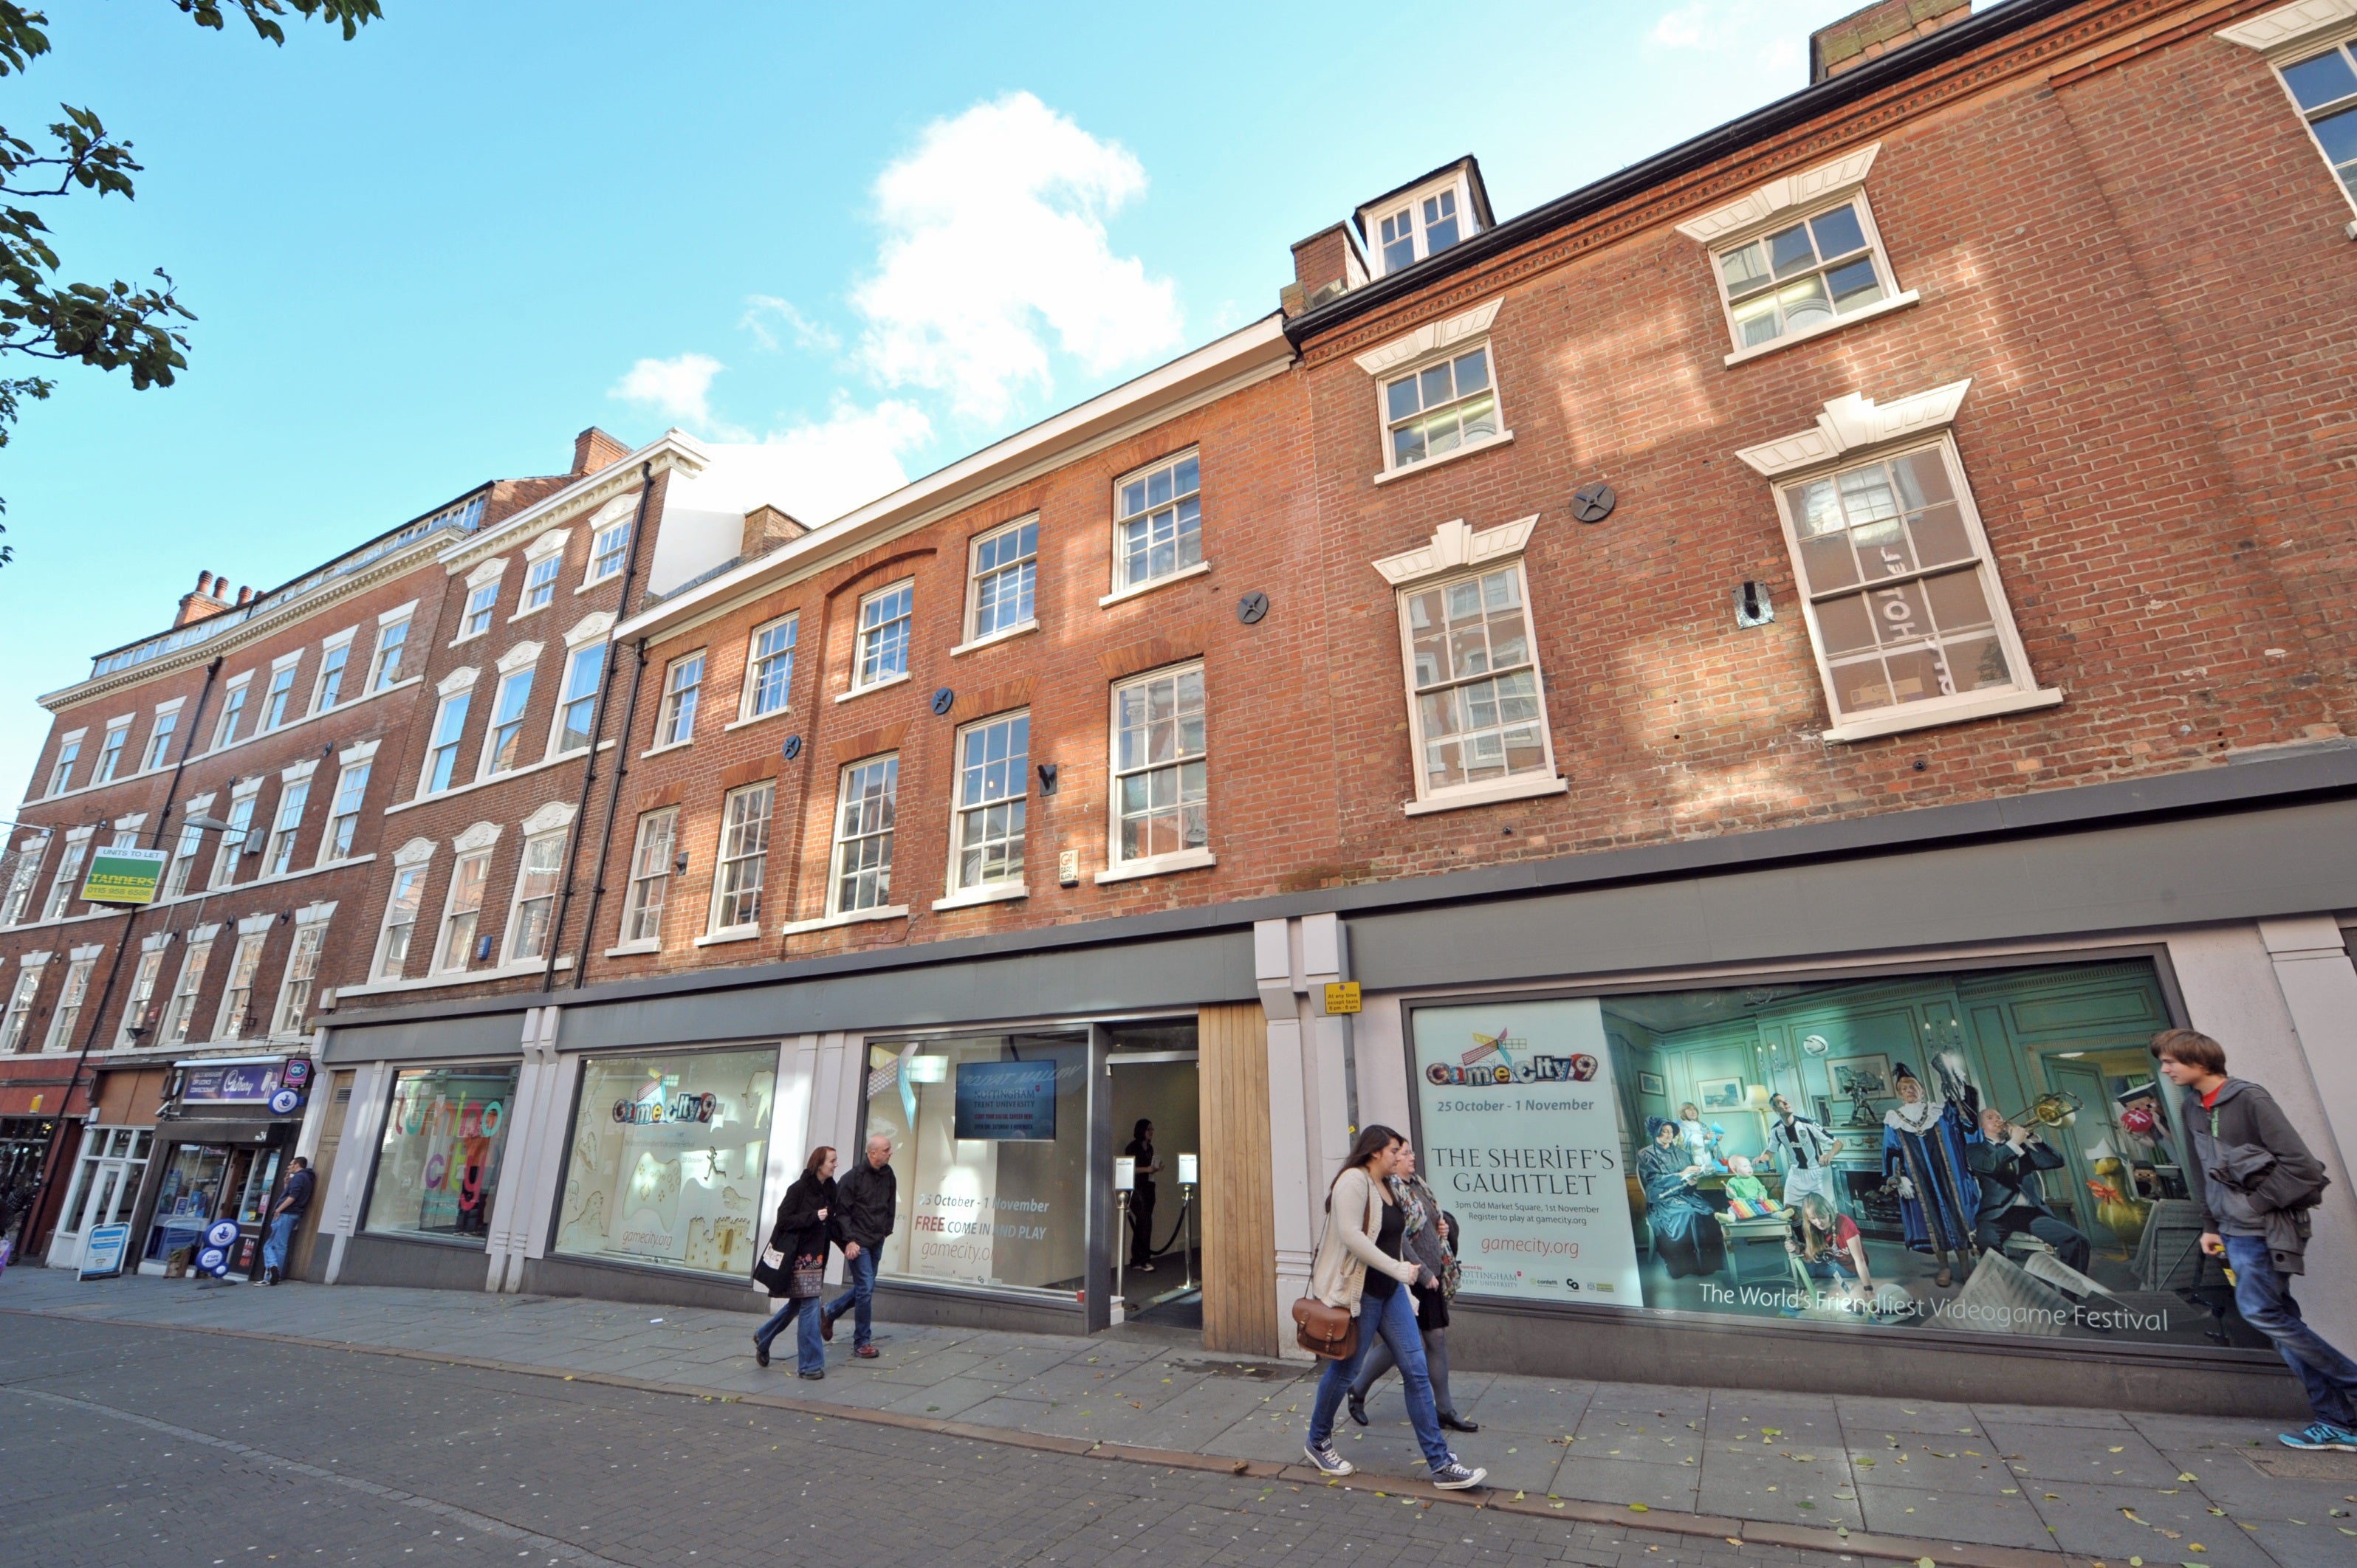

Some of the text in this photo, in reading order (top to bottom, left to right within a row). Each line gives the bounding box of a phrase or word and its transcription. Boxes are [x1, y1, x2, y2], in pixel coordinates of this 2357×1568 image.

[91, 873, 156, 887] TANNERS
[224, 1069, 254, 1096] Cadbury
[973, 1100, 1035, 1108] TRENT UNIVERSITY
[974, 1088, 1035, 1100] NOTTINGHAM
[395, 1090, 503, 1138] lumino
[1437, 1101, 1452, 1112] 25
[1455, 1100, 1505, 1112] October
[1515, 1101, 1522, 1111] 1
[1525, 1098, 1594, 1111] November
[1431, 1145, 1615, 1170] THE SHERIFF'S
[425, 1142, 487, 1211] city
[1452, 1172, 1596, 1196] GAUNTLET
[934, 1194, 975, 1208] October
[984, 1197, 989, 1208] 1
[992, 1197, 1050, 1213] November
[1455, 1200, 1599, 1214] 3pm Old Market Square, 1st November
[914, 1215, 1046, 1241] FREE COME IN AND PLAY
[1468, 1212, 1498, 1223] Register
[1509, 1214, 1526, 1225] play
[1536, 1217, 1587, 1227] gamecity.org
[622, 1231, 673, 1251] gamecity.org
[1481, 1237, 1579, 1259] gamecity.org
[921, 1241, 993, 1265] gamecity.o
[1478, 1280, 1518, 1289] UNIVERSITY
[1698, 1283, 2168, 1332] The World's Friendliest Videogame Festival
